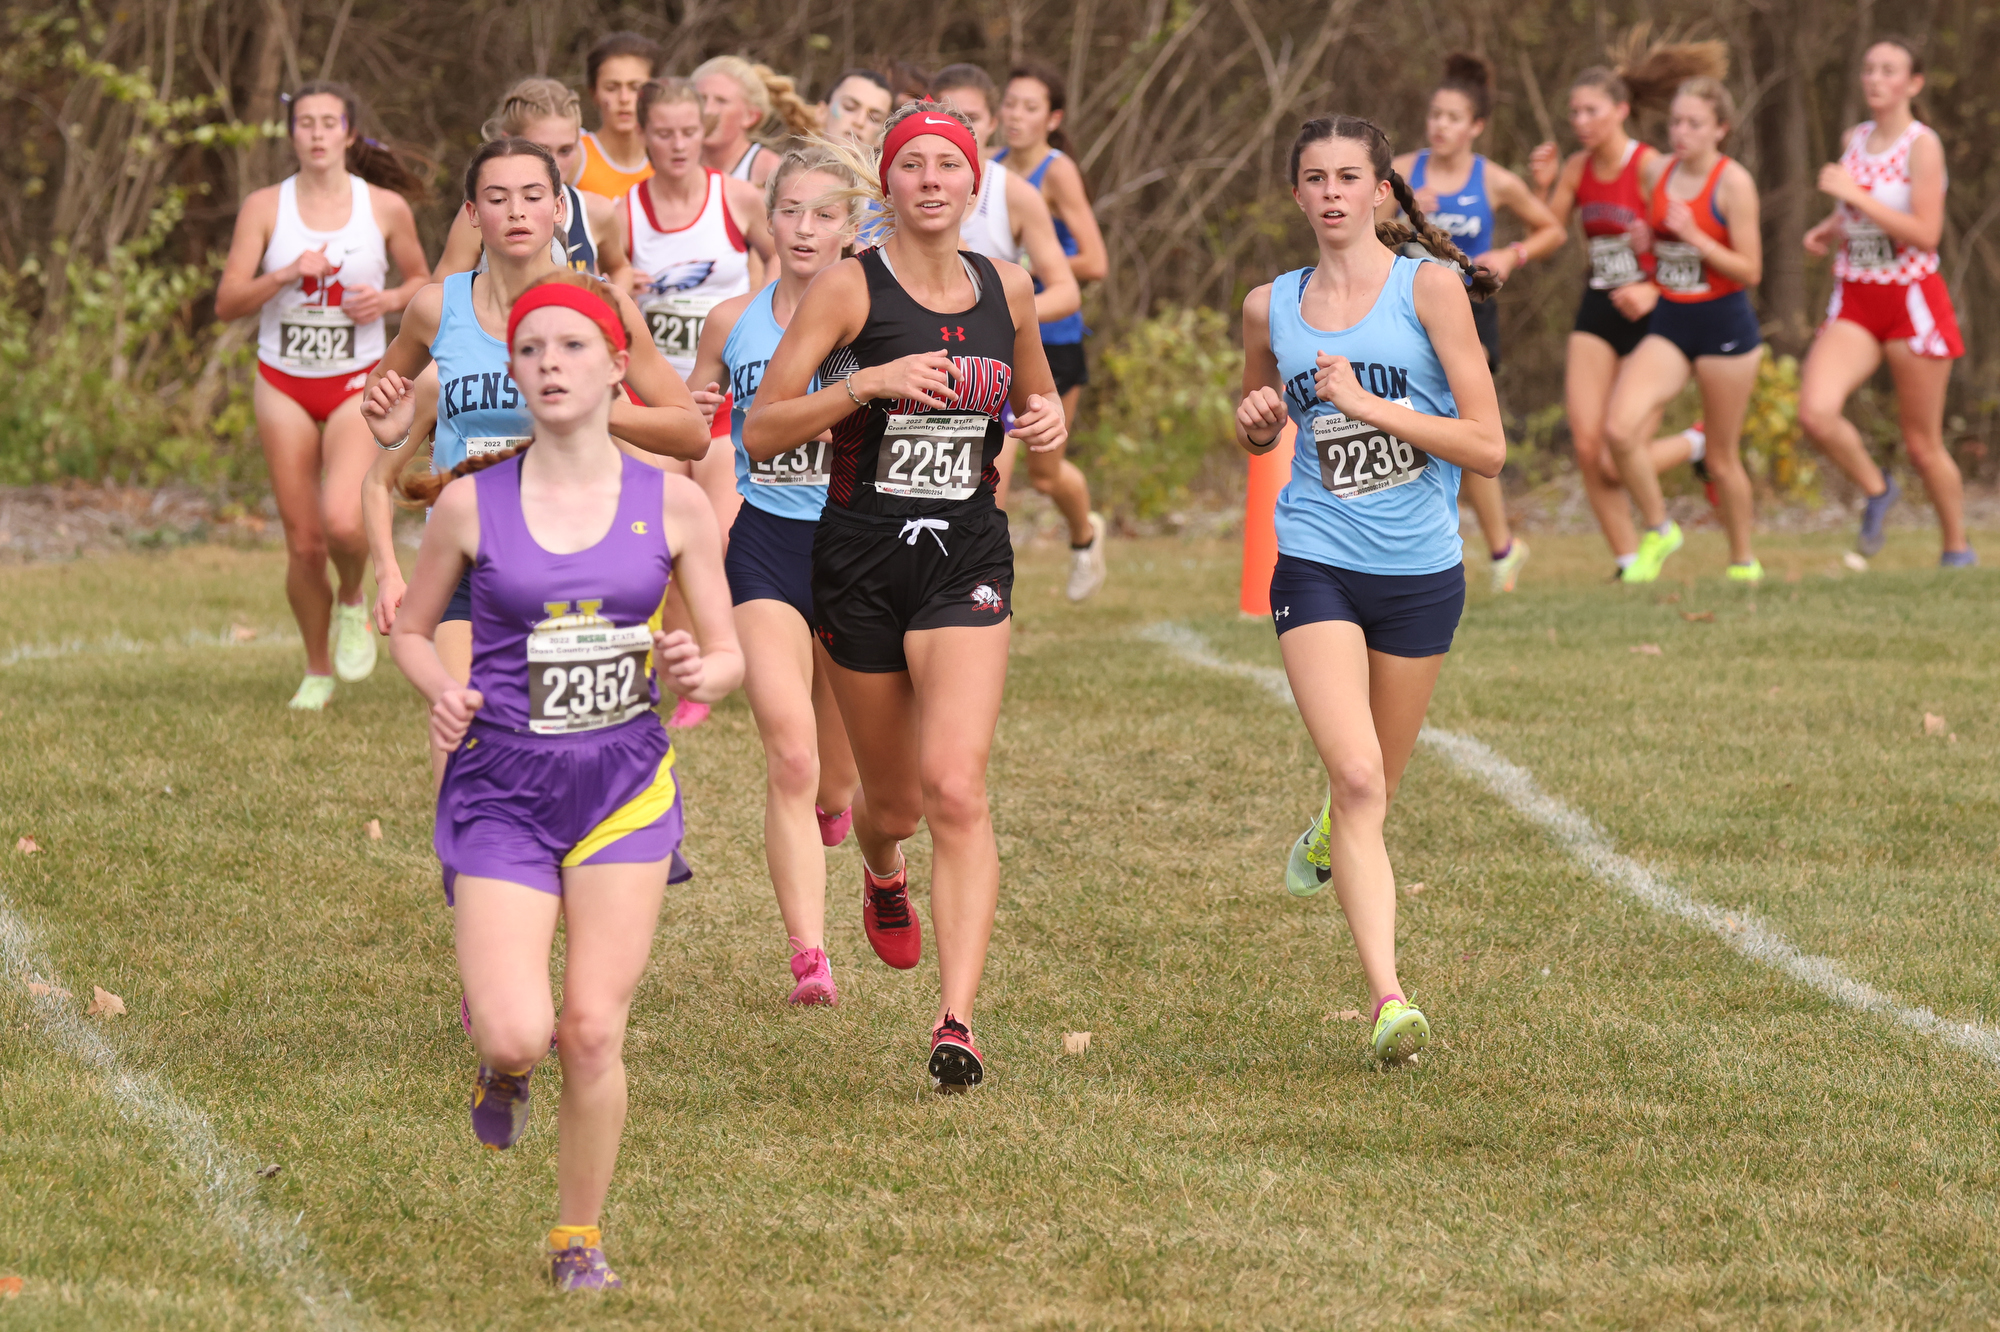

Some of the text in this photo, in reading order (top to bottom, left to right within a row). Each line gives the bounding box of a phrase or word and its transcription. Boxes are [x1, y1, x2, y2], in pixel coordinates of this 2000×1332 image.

[286, 326, 349, 359] 2292
[444, 372, 528, 420] KENS
[1285, 362, 1408, 413] KETON
[1326, 417, 1342, 425] 2022
[1333, 423, 1359, 432] Country
[757, 441, 827, 471] 237
[888, 439, 972, 485] 2254
[1328, 435, 1415, 486] 2236
[529, 647, 554, 655] Cross
[556, 644, 591, 655] Country
[542, 656, 640, 716] 2352
